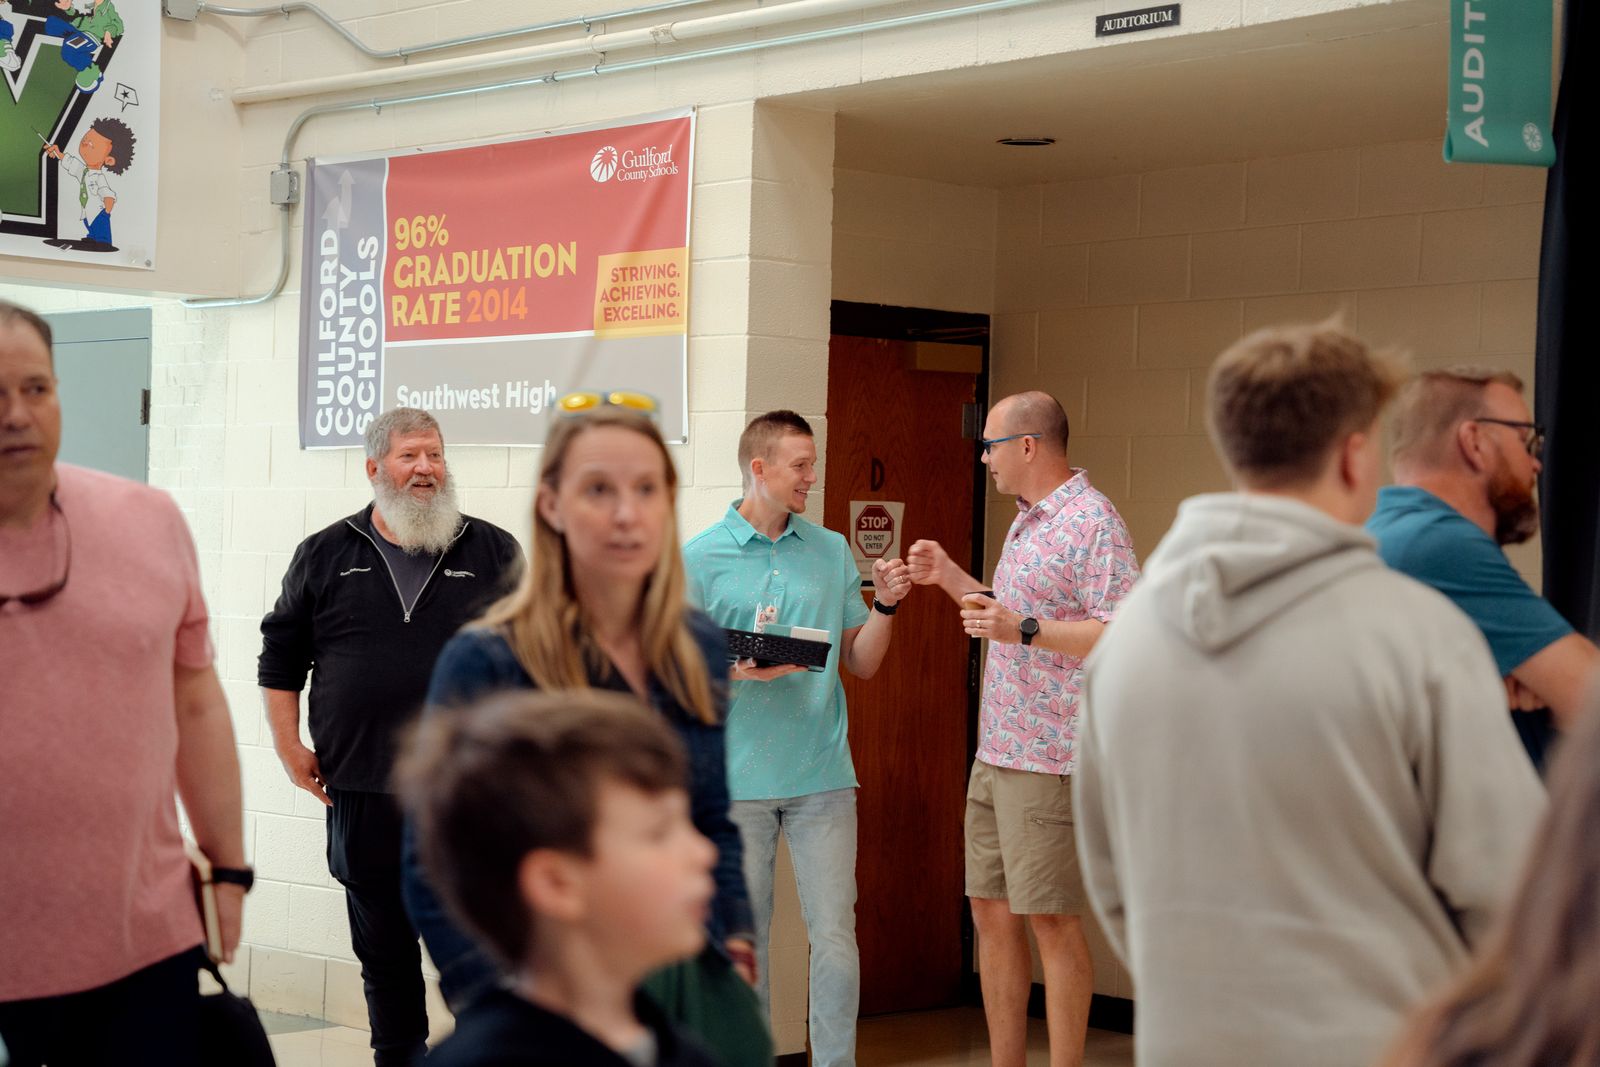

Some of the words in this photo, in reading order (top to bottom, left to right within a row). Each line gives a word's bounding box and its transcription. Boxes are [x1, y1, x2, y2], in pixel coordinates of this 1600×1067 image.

[1102, 10, 1173, 31] AUDITORIUM
[1462, 0, 1489, 148] AUDIT
[617, 168, 648, 182] County
[648, 162, 679, 178] Schools
[621, 144, 673, 169] Guilford
[394, 213, 449, 251] 96%
[393, 241, 577, 289] GRADUATION
[611, 262, 680, 283] STRIVING.
[391, 291, 461, 327] RATE
[466, 286, 528, 323] 2014
[600, 282, 680, 303] ACHIEVING.
[603, 302, 680, 323] EXCELLING.
[315, 229, 339, 436] GUILFORD
[335, 263, 357, 436] COUNTY
[356, 235, 379, 435] SCHOOLS
[396, 383, 500, 411] Southwest
[506, 380, 557, 415] High
[870, 457, 885, 492] D
[861, 516, 889, 529] STOP
